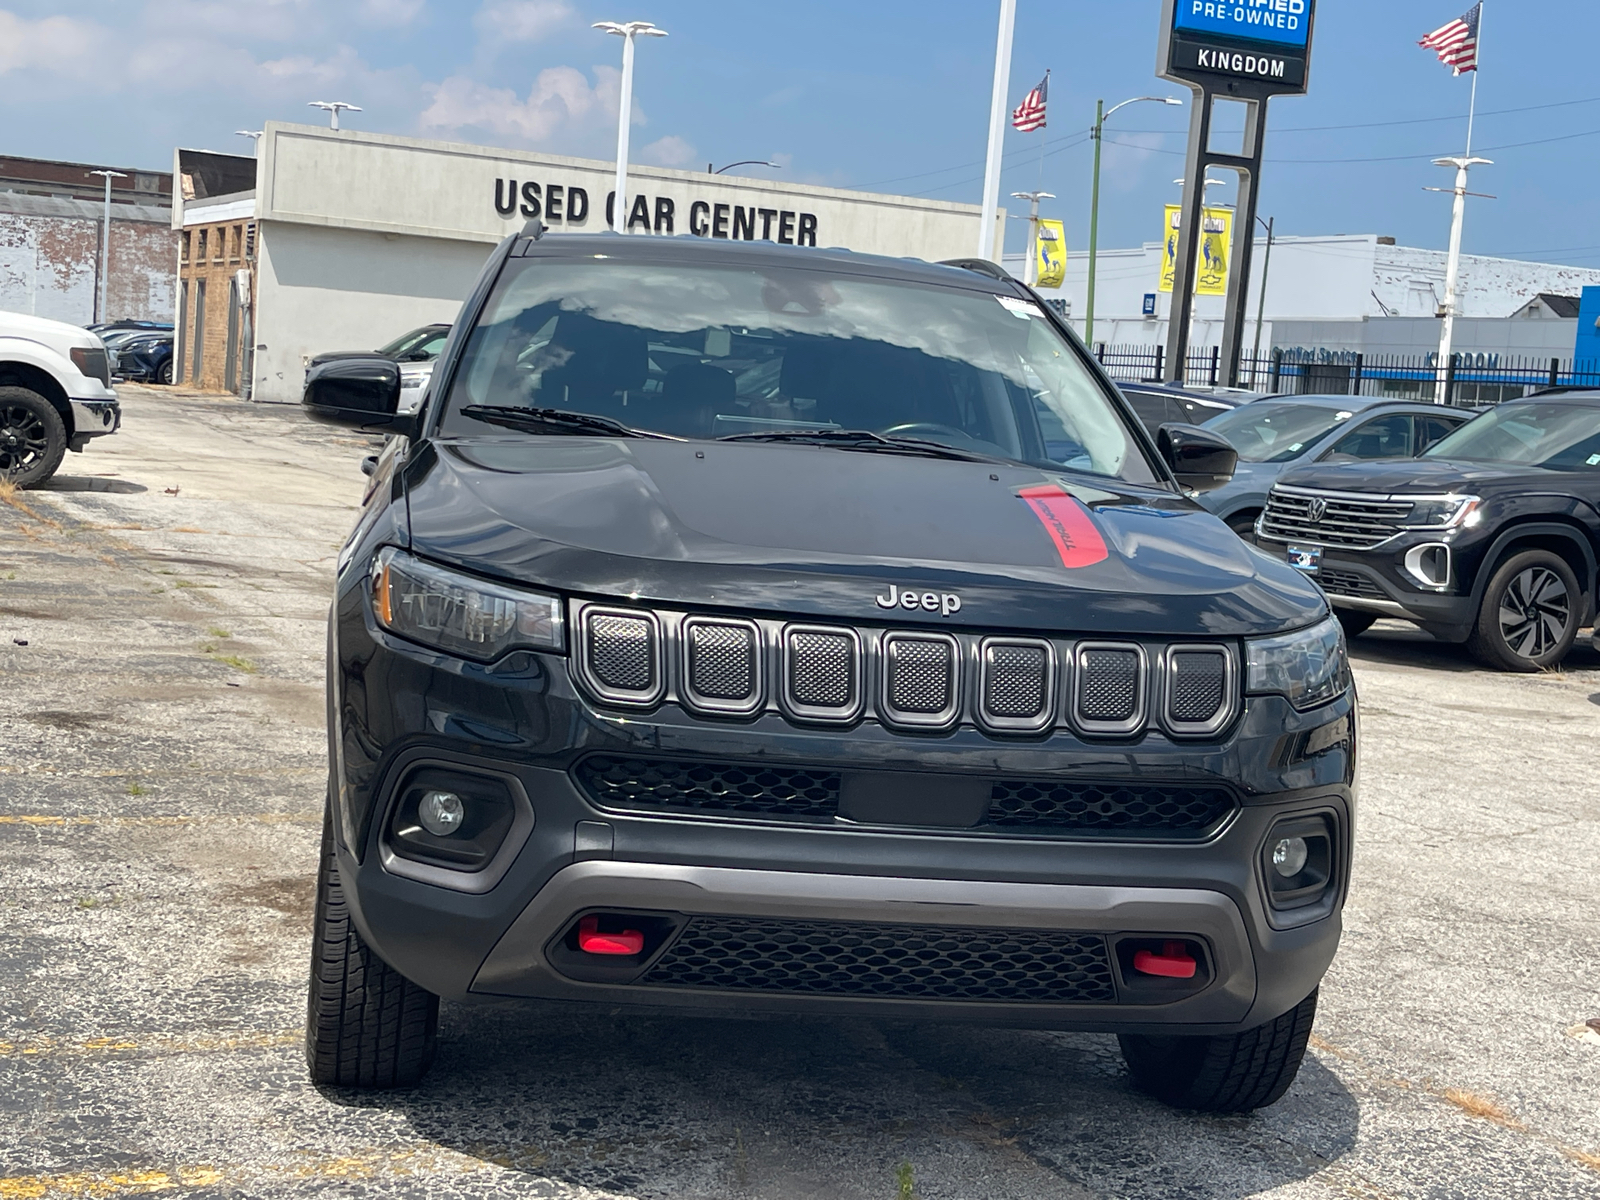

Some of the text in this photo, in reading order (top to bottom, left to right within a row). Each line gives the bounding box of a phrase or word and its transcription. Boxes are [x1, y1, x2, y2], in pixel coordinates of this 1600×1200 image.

[1192, 1, 1298, 30] PRE-OWNED
[1198, 49, 1284, 77] KINGDOM
[495, 178, 588, 222] USED
[689, 200, 817, 247] CENTER
[876, 584, 962, 618] Jeep
